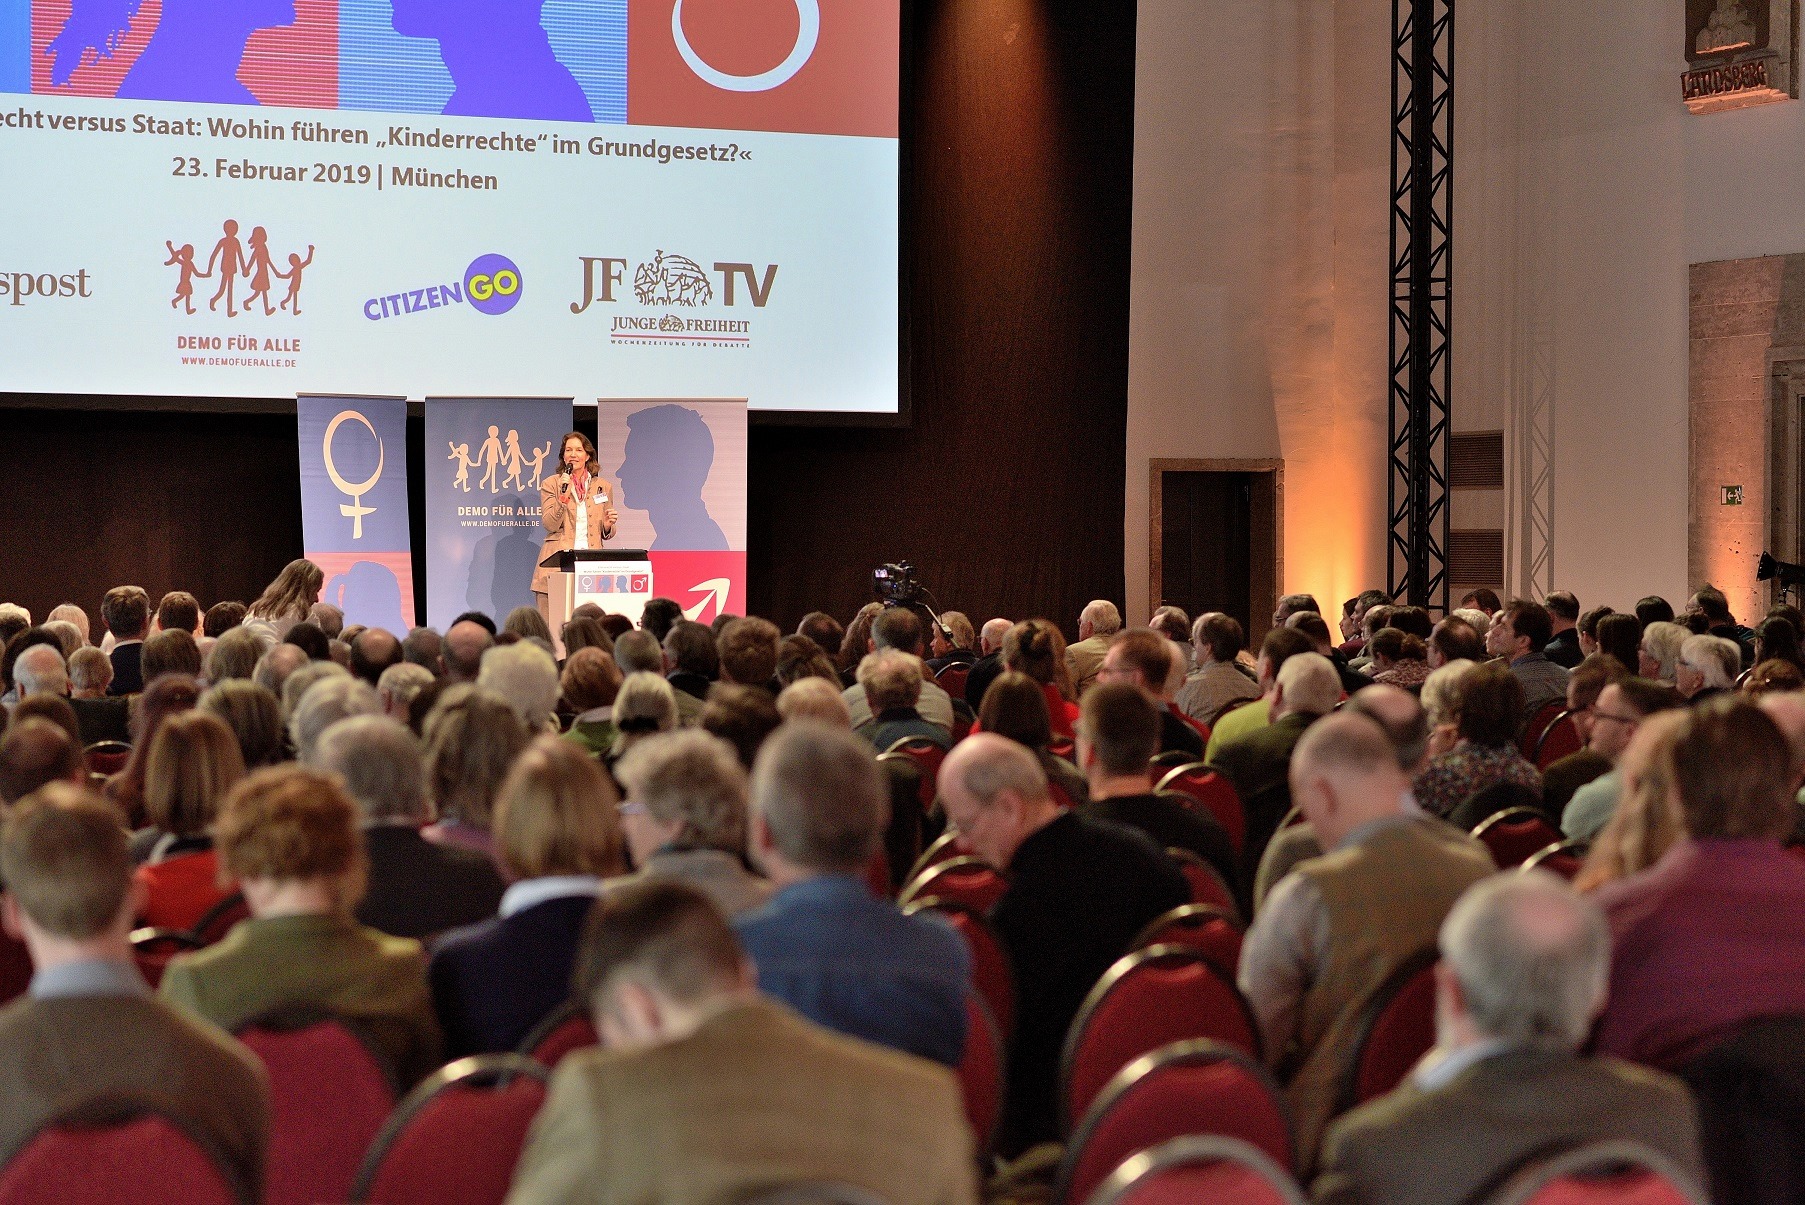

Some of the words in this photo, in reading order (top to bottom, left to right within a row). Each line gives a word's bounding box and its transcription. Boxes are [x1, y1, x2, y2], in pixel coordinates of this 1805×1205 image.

[1680, 61, 1767, 100] LANDSBERG
[47, 114, 126, 133] versus
[132, 113, 202, 137] Staat:
[207, 117, 285, 141] Wohin
[291, 120, 369, 145] führen
[552, 133, 581, 155] im
[172, 156, 209, 178] 23.
[215, 158, 309, 182] Februar
[313, 162, 371, 185] 2019
[392, 166, 498, 190] München
[570, 256, 627, 315] JF
[713, 262, 779, 308] TV
[610, 316, 658, 332] JUNGE
[686, 319, 751, 333] FREIHEIT
[177, 335, 222, 350] DEMO
[227, 334, 258, 351] FÜR
[263, 338, 301, 352] ALLE
[181, 356, 297, 368] WWW.DEMOFUERALLE.DE
[457, 506, 488, 516] DEMO
[492, 504, 513, 516] FÜR
[516, 506, 543, 516] ALLE
